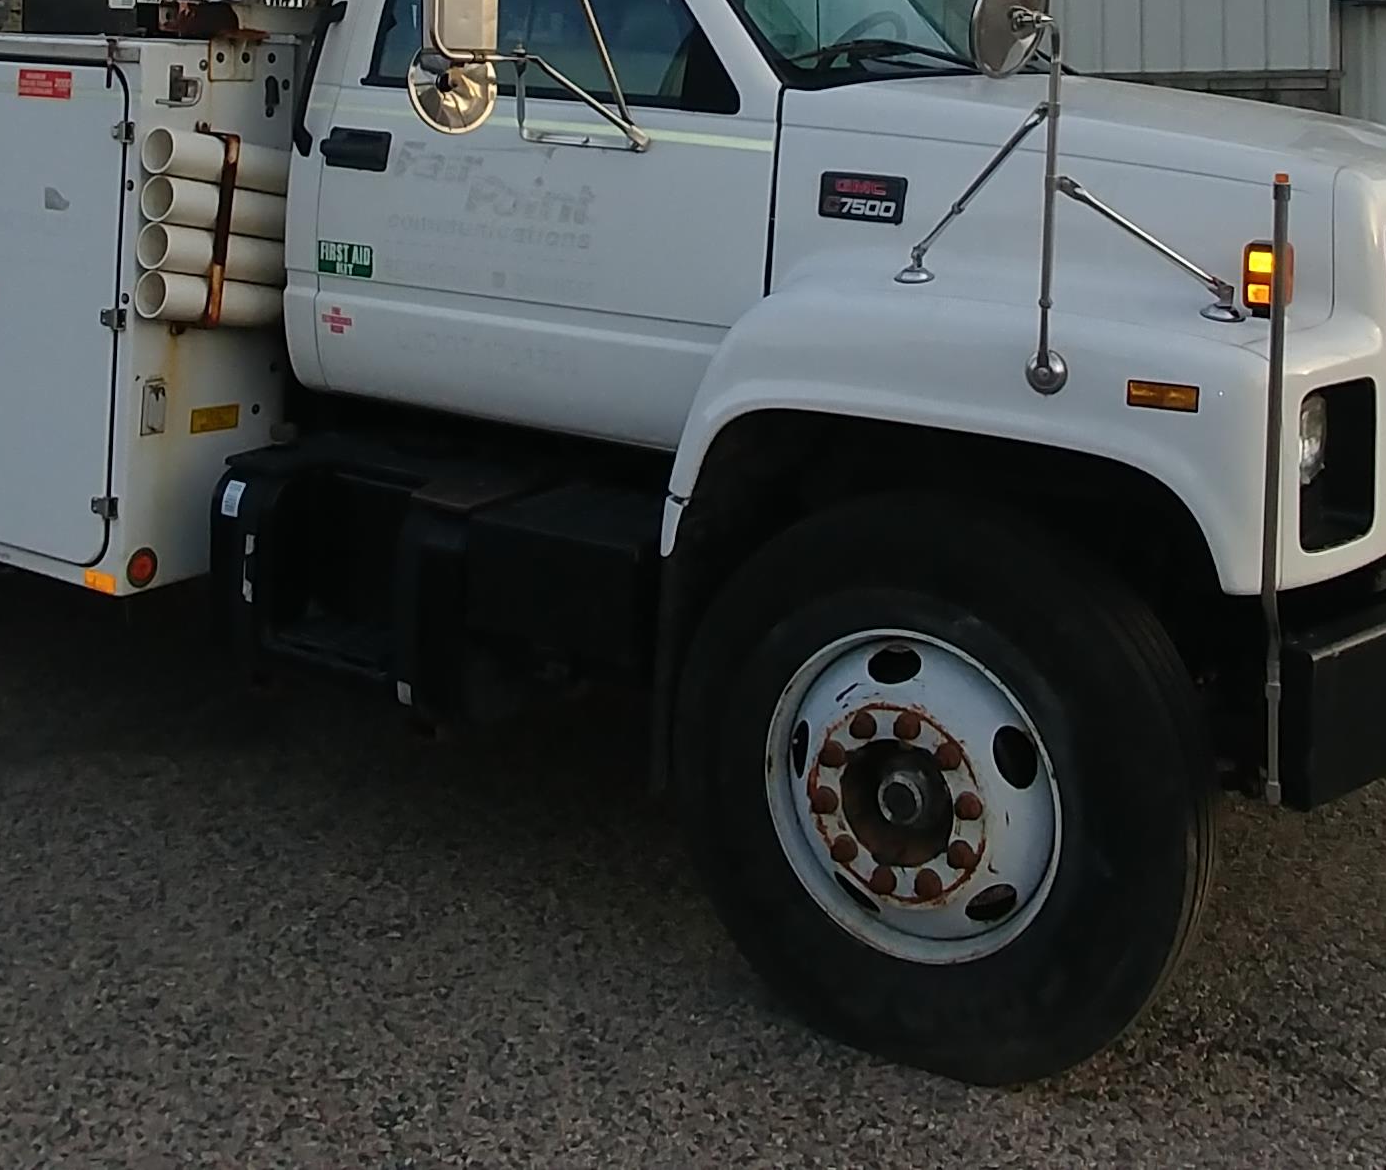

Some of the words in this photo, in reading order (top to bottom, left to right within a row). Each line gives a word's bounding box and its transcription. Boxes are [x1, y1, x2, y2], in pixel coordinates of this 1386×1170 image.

[835, 177, 887, 196] GMC
[320, 242, 350, 262] FIRST
[351, 245, 371, 266] AID
[336, 262, 354, 275] KIT
